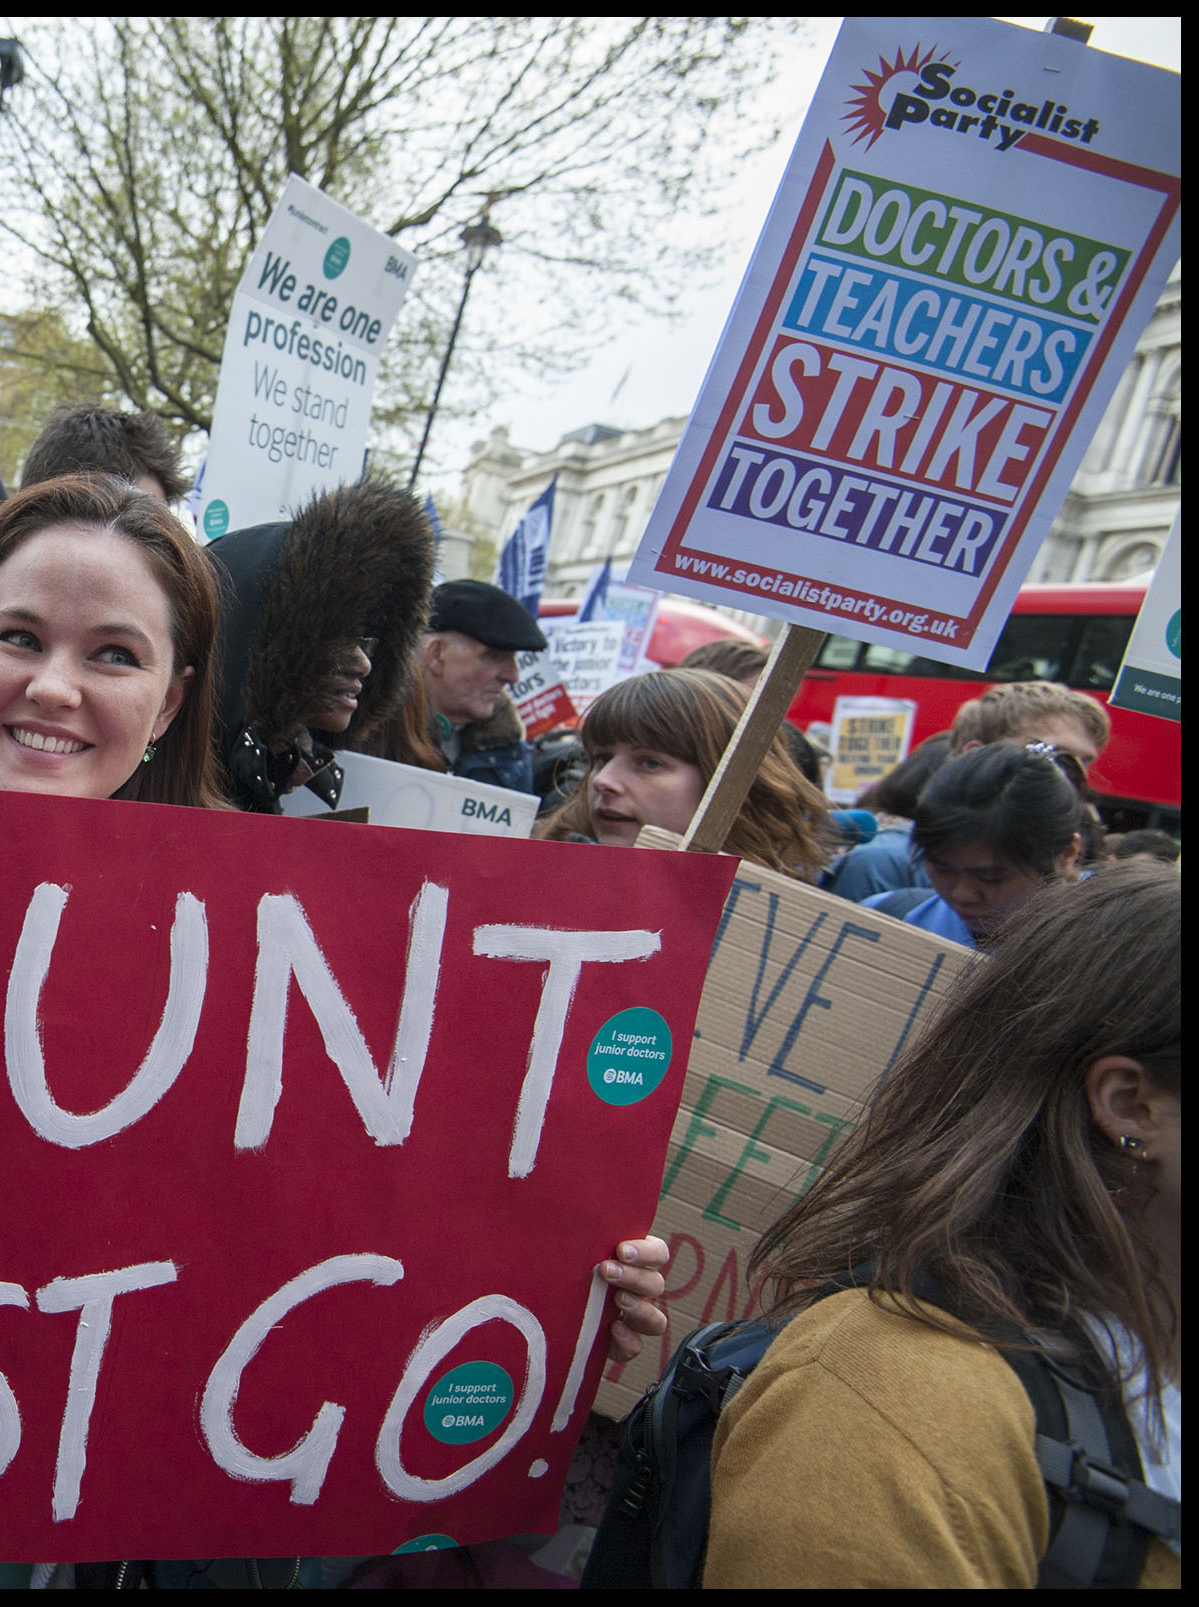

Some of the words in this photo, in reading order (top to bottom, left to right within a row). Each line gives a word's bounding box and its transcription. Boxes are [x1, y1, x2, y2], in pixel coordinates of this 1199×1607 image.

[884, 92, 1026, 151] Party
[913, 62, 1101, 144] Socialist
[383, 254, 407, 284] BMA
[822, 179, 1074, 305] DOCTORS
[1068, 250, 1118, 320] &
[258, 251, 297, 302] We
[298, 285, 338, 323] are
[339, 306, 382, 345] one
[796, 257, 1077, 395] TEACHERS
[243, 309, 367, 386] profession
[253, 360, 288, 407] We
[292, 384, 350, 430] stand
[752, 342, 1053, 502] STRIKE
[248, 413, 339, 470] together
[718, 446, 994, 573] TOGETHER
[674, 553, 960, 640] www.socialistparty.org.uk
[1134, 683, 1146, 695] We
[461, 798, 512, 826] BMA
[594, 1042, 626, 1056] junior
[627, 1046, 666, 1061] doctors
[611, 1030, 617, 1041] I
[617, 1033, 657, 1046] support
[616, 1070, 643, 1086] BMA
[196, 1253, 608, 1506] GO!
[431, 1394, 465, 1407] junior
[466, 1394, 507, 1404] doctors
[448, 1383, 454, 1393] I
[454, 1384, 497, 1395] support
[455, 1415, 485, 1427] BMA
